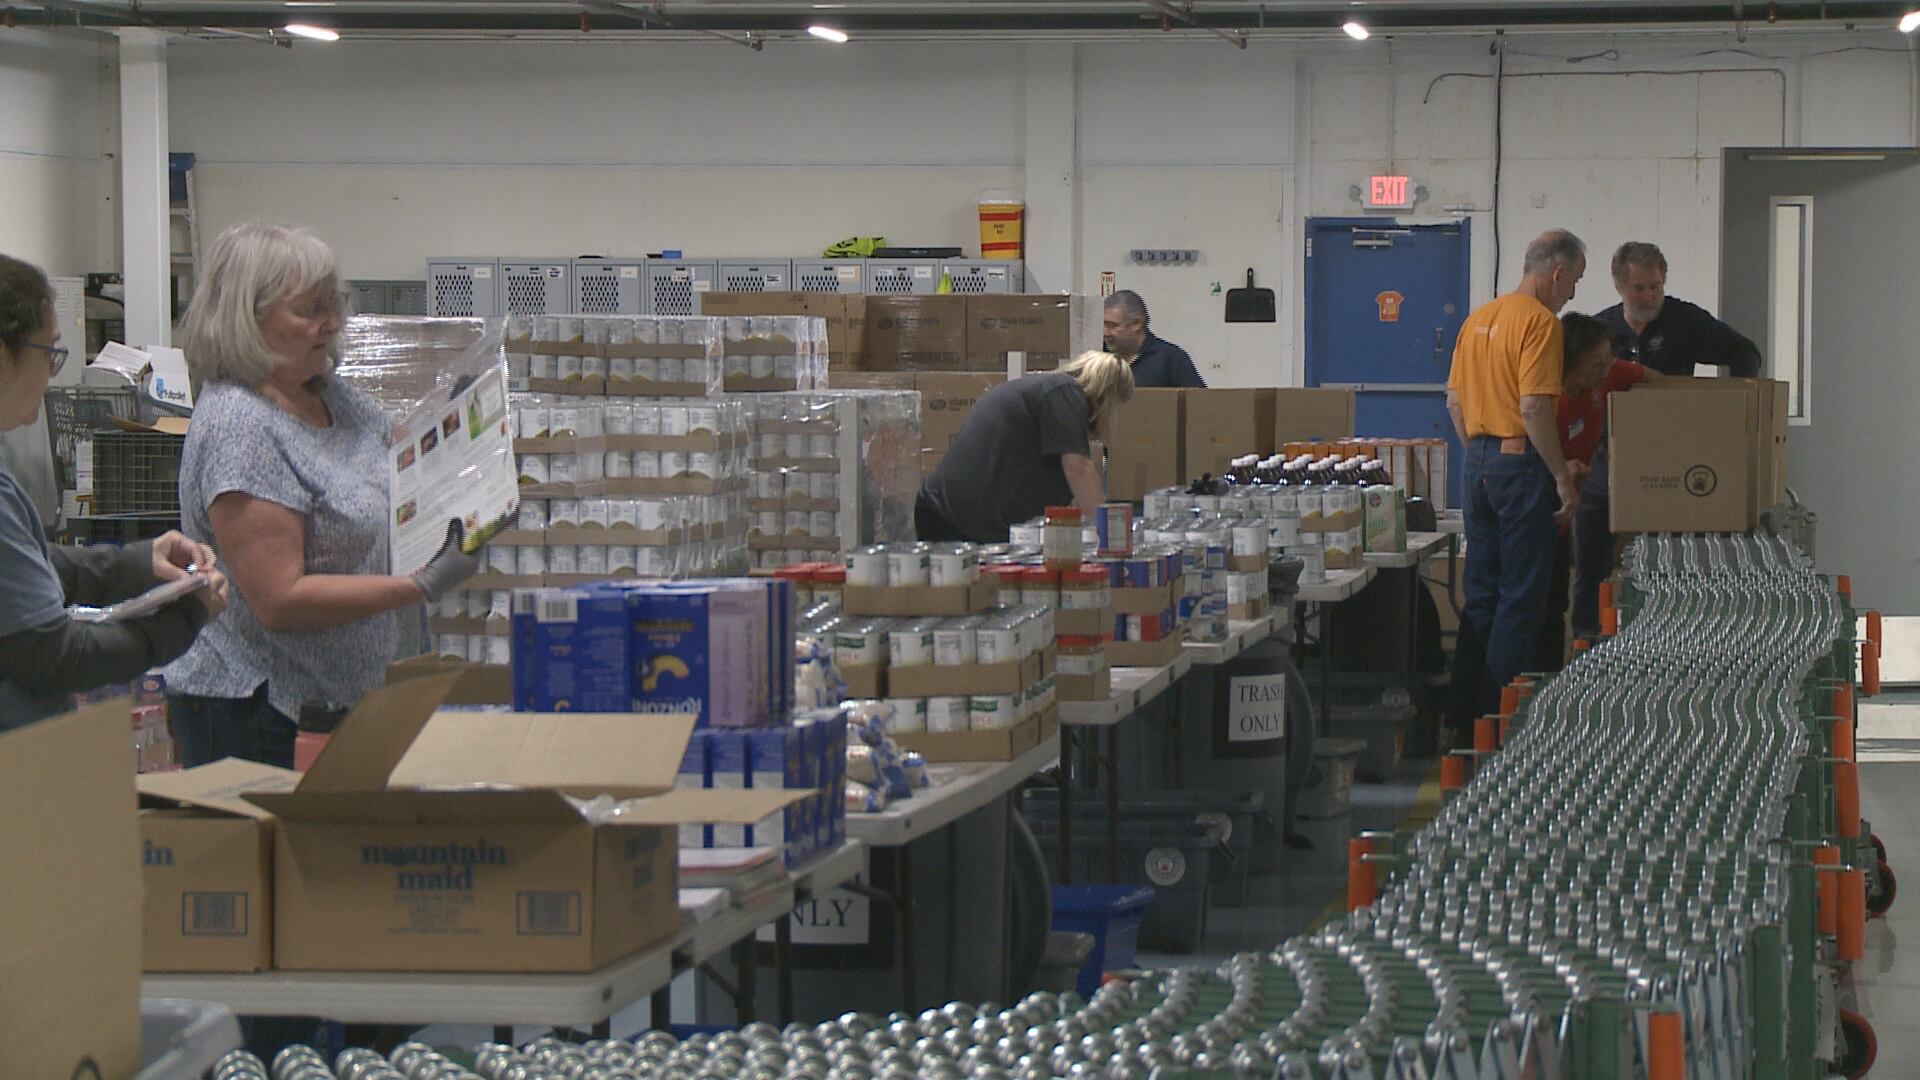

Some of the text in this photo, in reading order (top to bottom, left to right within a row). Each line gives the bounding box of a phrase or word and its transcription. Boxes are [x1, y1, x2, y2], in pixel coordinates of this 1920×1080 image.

[1370, 175, 1408, 205] EXIT
[1236, 684, 1283, 702] TRASH
[1240, 712, 1280, 733] ONLY
[397, 865, 475, 890] maid
[793, 898, 852, 928] NLY
